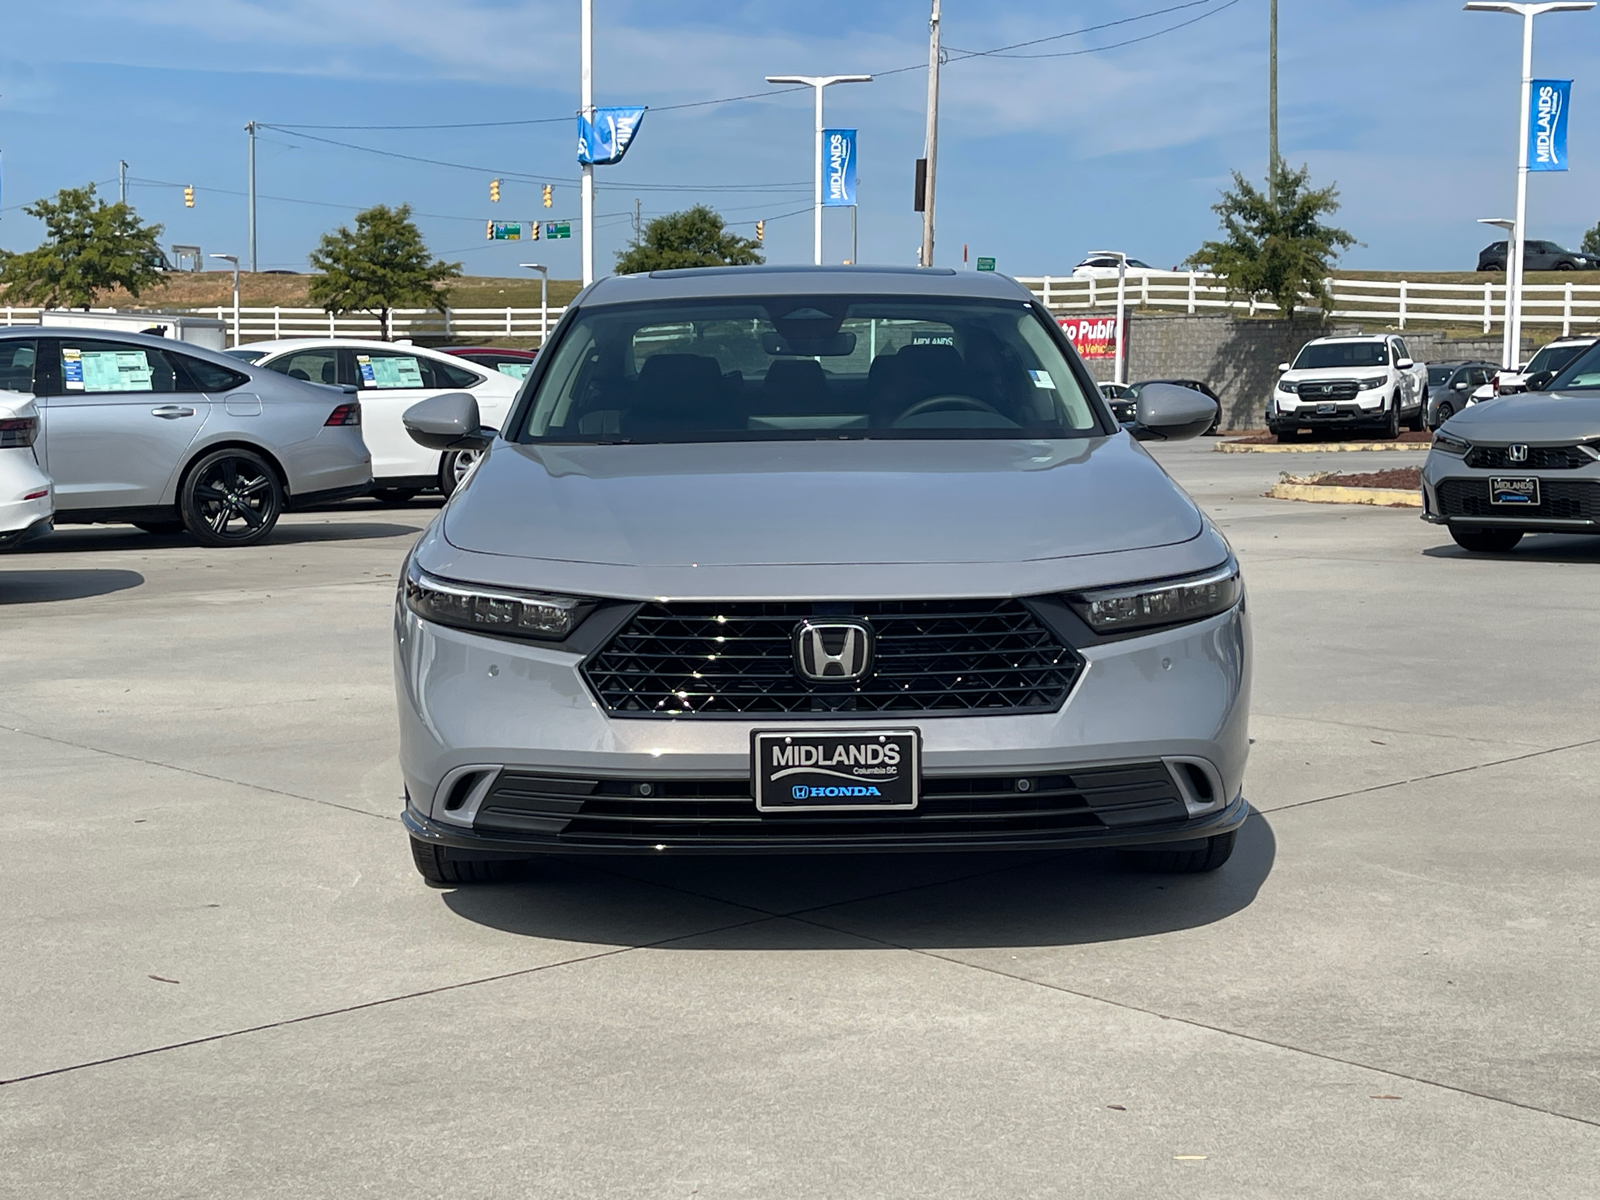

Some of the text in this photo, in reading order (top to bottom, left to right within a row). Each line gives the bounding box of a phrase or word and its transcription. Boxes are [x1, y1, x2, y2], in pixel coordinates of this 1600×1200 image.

[1536, 86, 1553, 162] MIDLANDS
[830, 134, 842, 199] MIDLANDS
[1494, 481, 1534, 490] MIDLANDS
[772, 743, 901, 766] MIDLANDS
[853, 766, 898, 774] Columbia SC
[810, 786, 881, 797] HONDA
